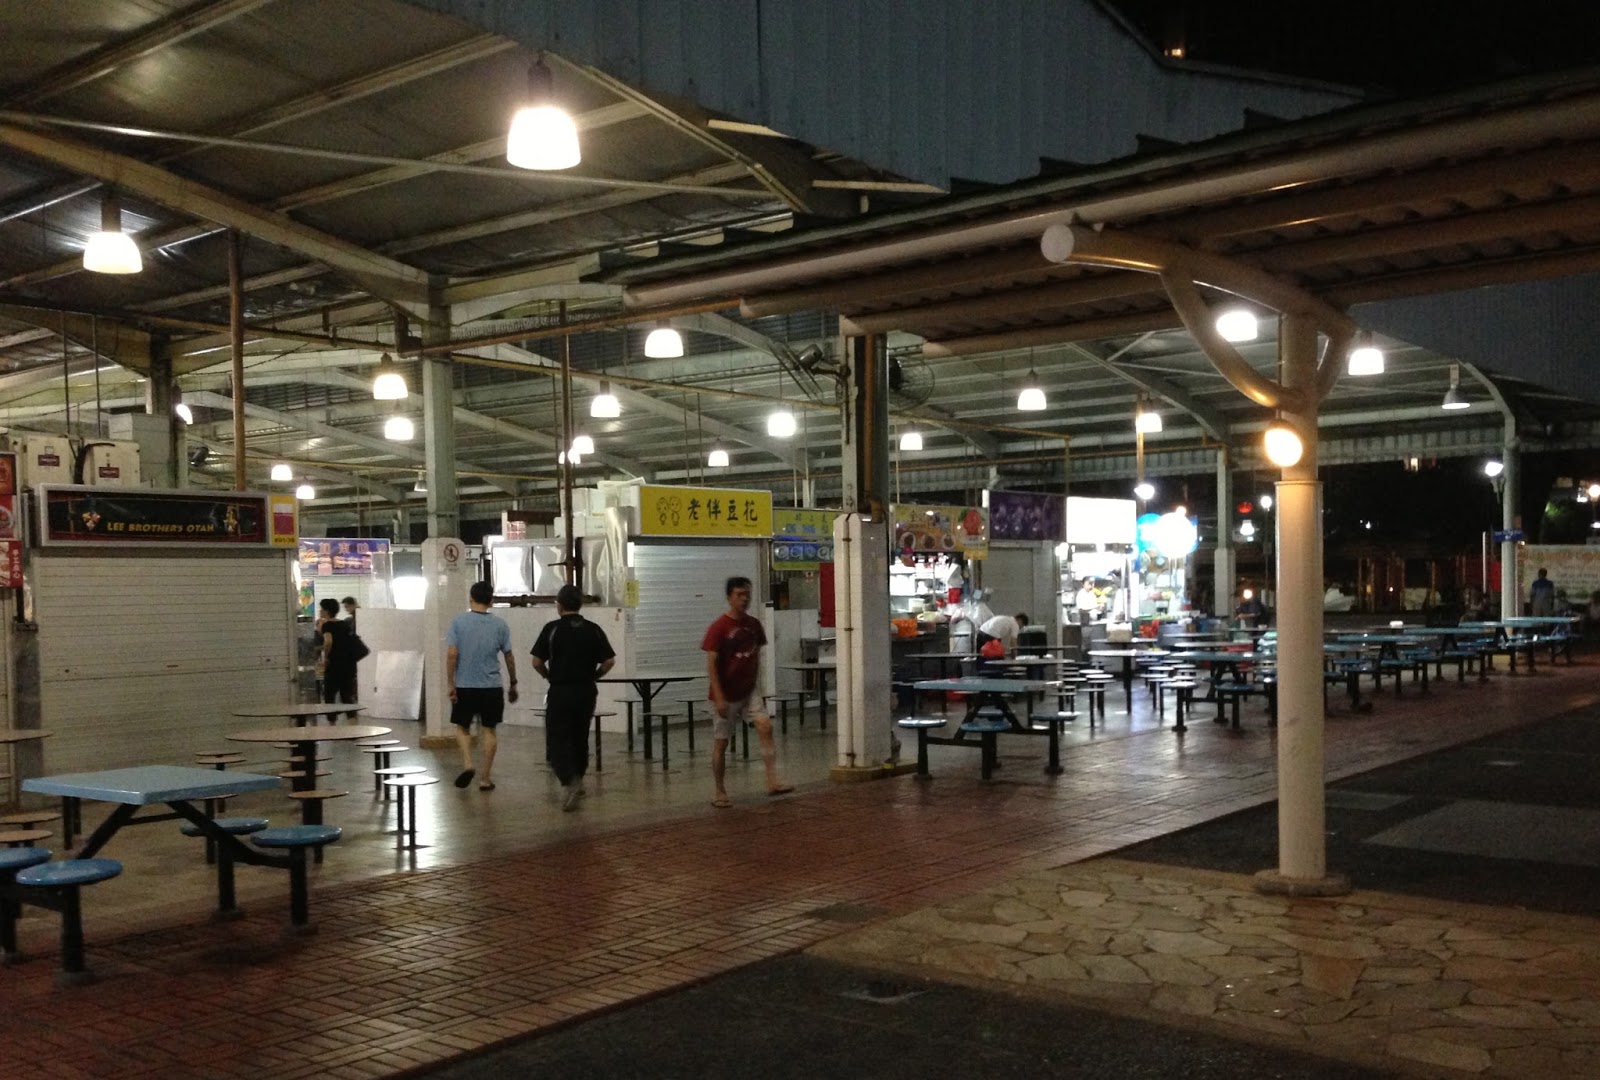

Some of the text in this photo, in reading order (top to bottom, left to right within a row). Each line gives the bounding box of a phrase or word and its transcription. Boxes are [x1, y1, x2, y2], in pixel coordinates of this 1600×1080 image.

[687, 498, 758, 521] 老伴豆花
[107, 521, 125, 532] LEE
